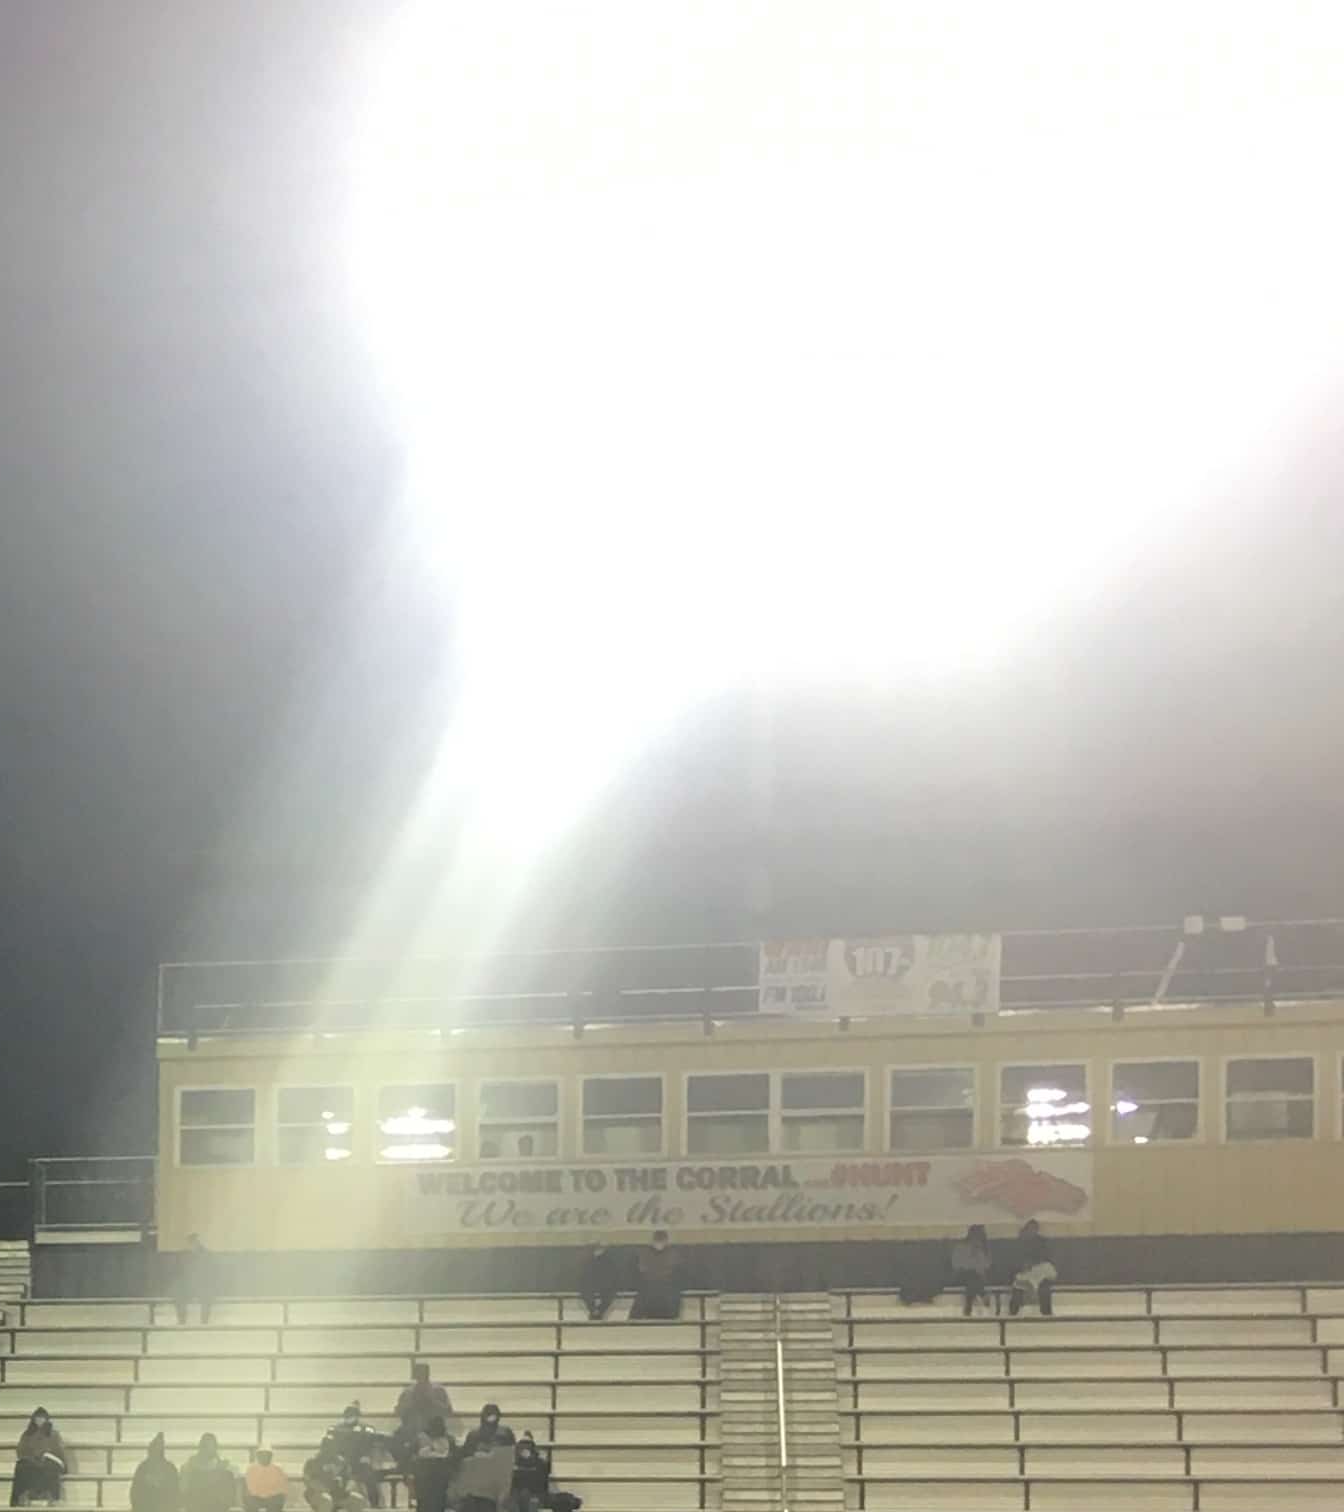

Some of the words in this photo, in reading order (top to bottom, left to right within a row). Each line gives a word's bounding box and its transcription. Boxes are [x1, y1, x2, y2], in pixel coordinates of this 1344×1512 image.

[417, 1169, 564, 1195] WELCOME
[569, 1168, 608, 1193] TO
[614, 1167, 668, 1192] THE
[676, 1165, 799, 1190] CORRAL
[457, 1199, 534, 1228] We
[545, 1206, 612, 1226] are
[625, 1194, 685, 1225] the
[700, 1192, 900, 1224] Stallions!
